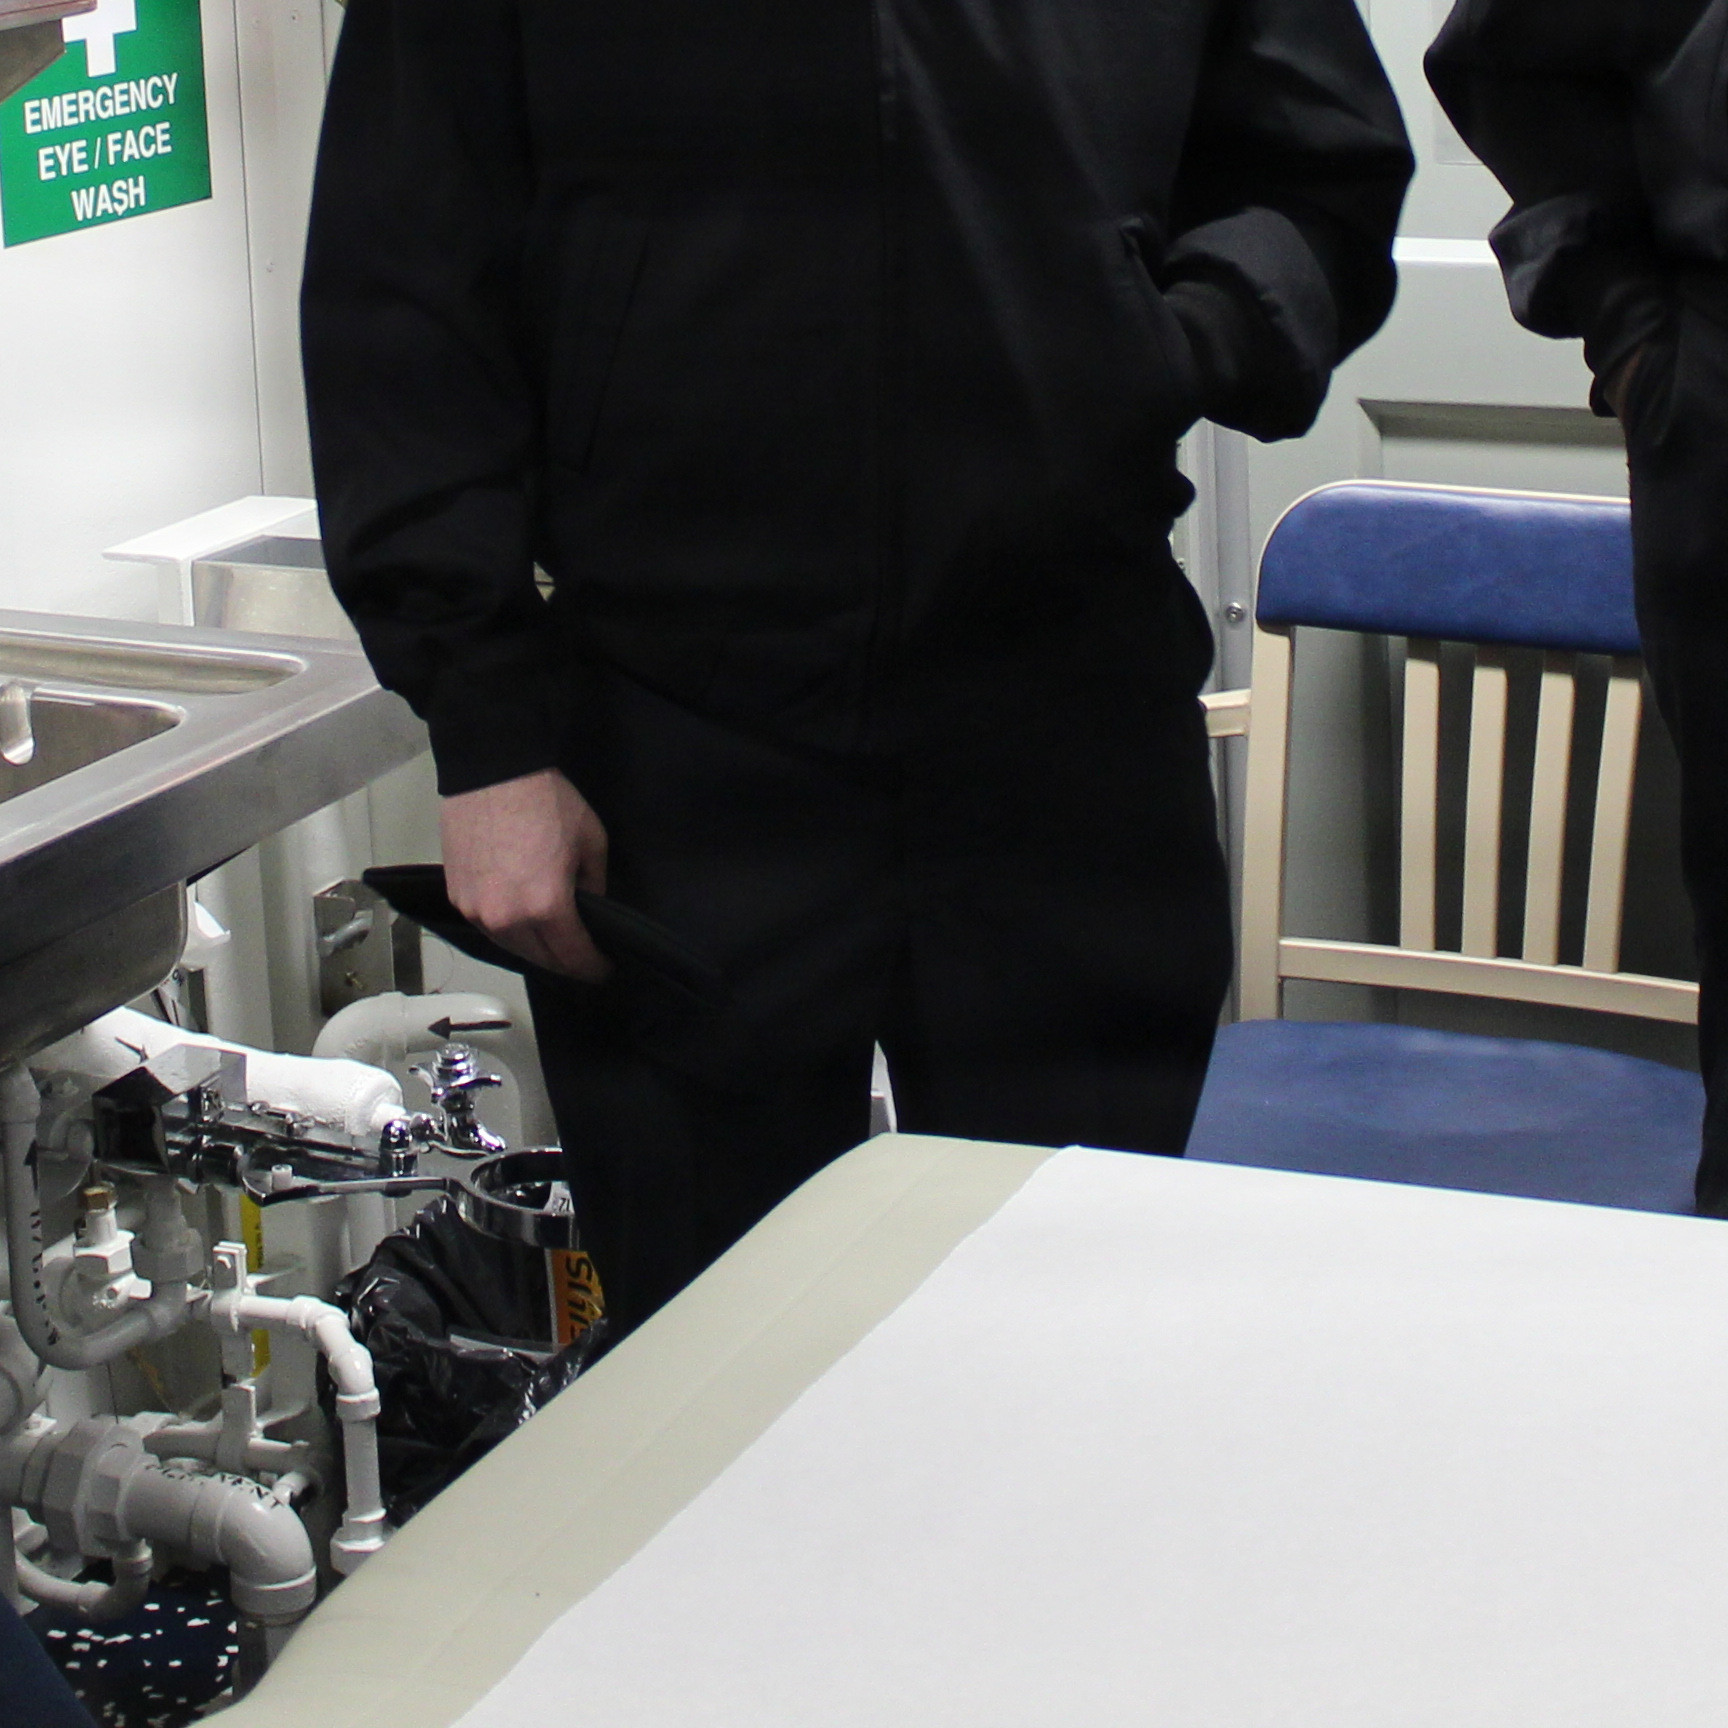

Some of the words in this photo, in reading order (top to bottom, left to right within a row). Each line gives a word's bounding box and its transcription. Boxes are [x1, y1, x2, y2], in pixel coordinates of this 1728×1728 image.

[24, 72, 178, 134] EMERGENCY
[38, 139, 89, 181] EYE
[94, 137, 102, 170] /
[106, 121, 172, 166] FACE
[70, 175, 146, 221] WASH
